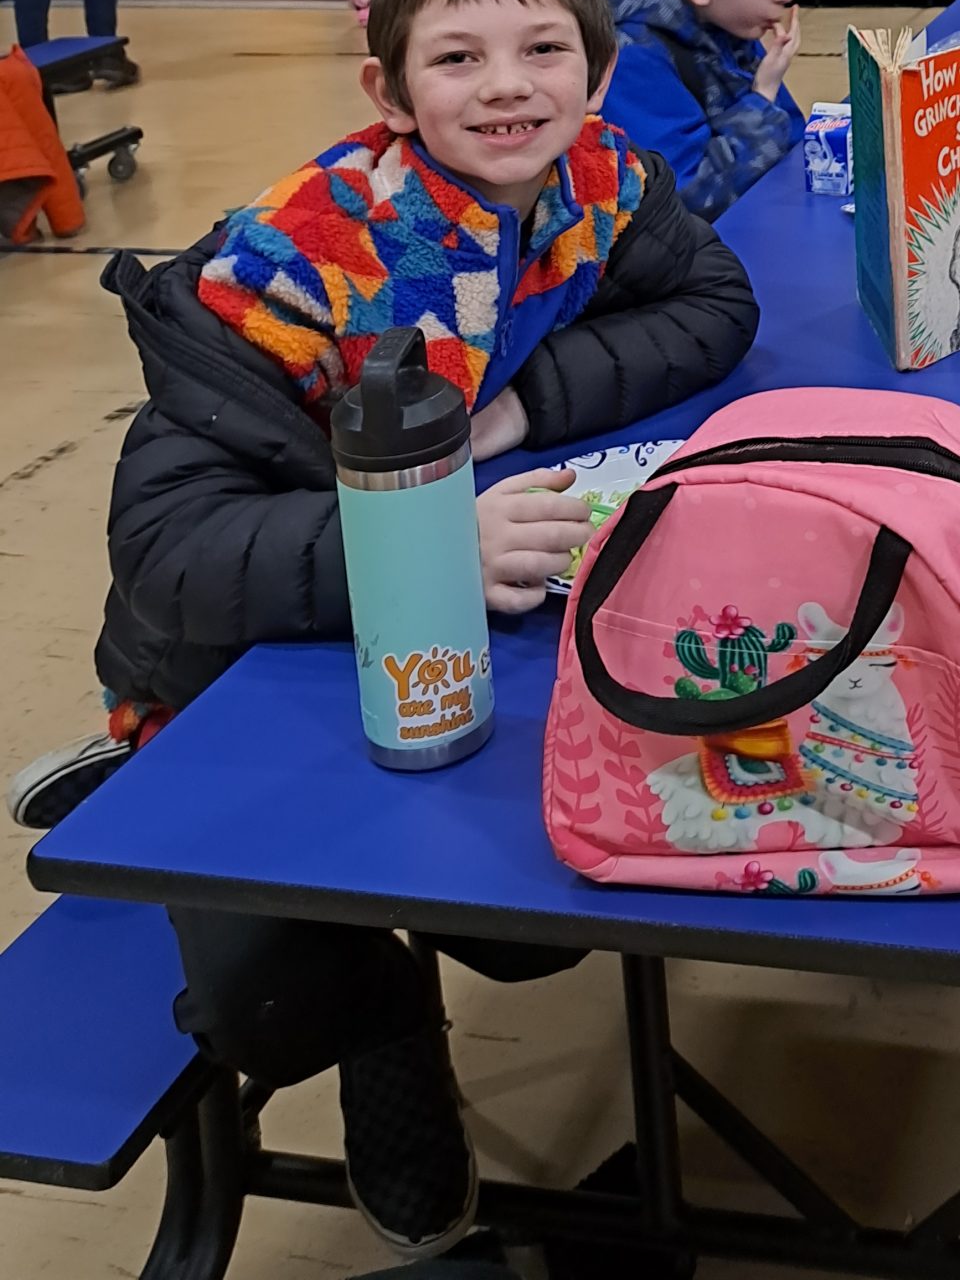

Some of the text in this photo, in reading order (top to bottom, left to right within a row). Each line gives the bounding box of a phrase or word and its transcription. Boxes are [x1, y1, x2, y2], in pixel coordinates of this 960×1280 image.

[399, 685, 472, 717] are my
[400, 709, 474, 739] sunshine
